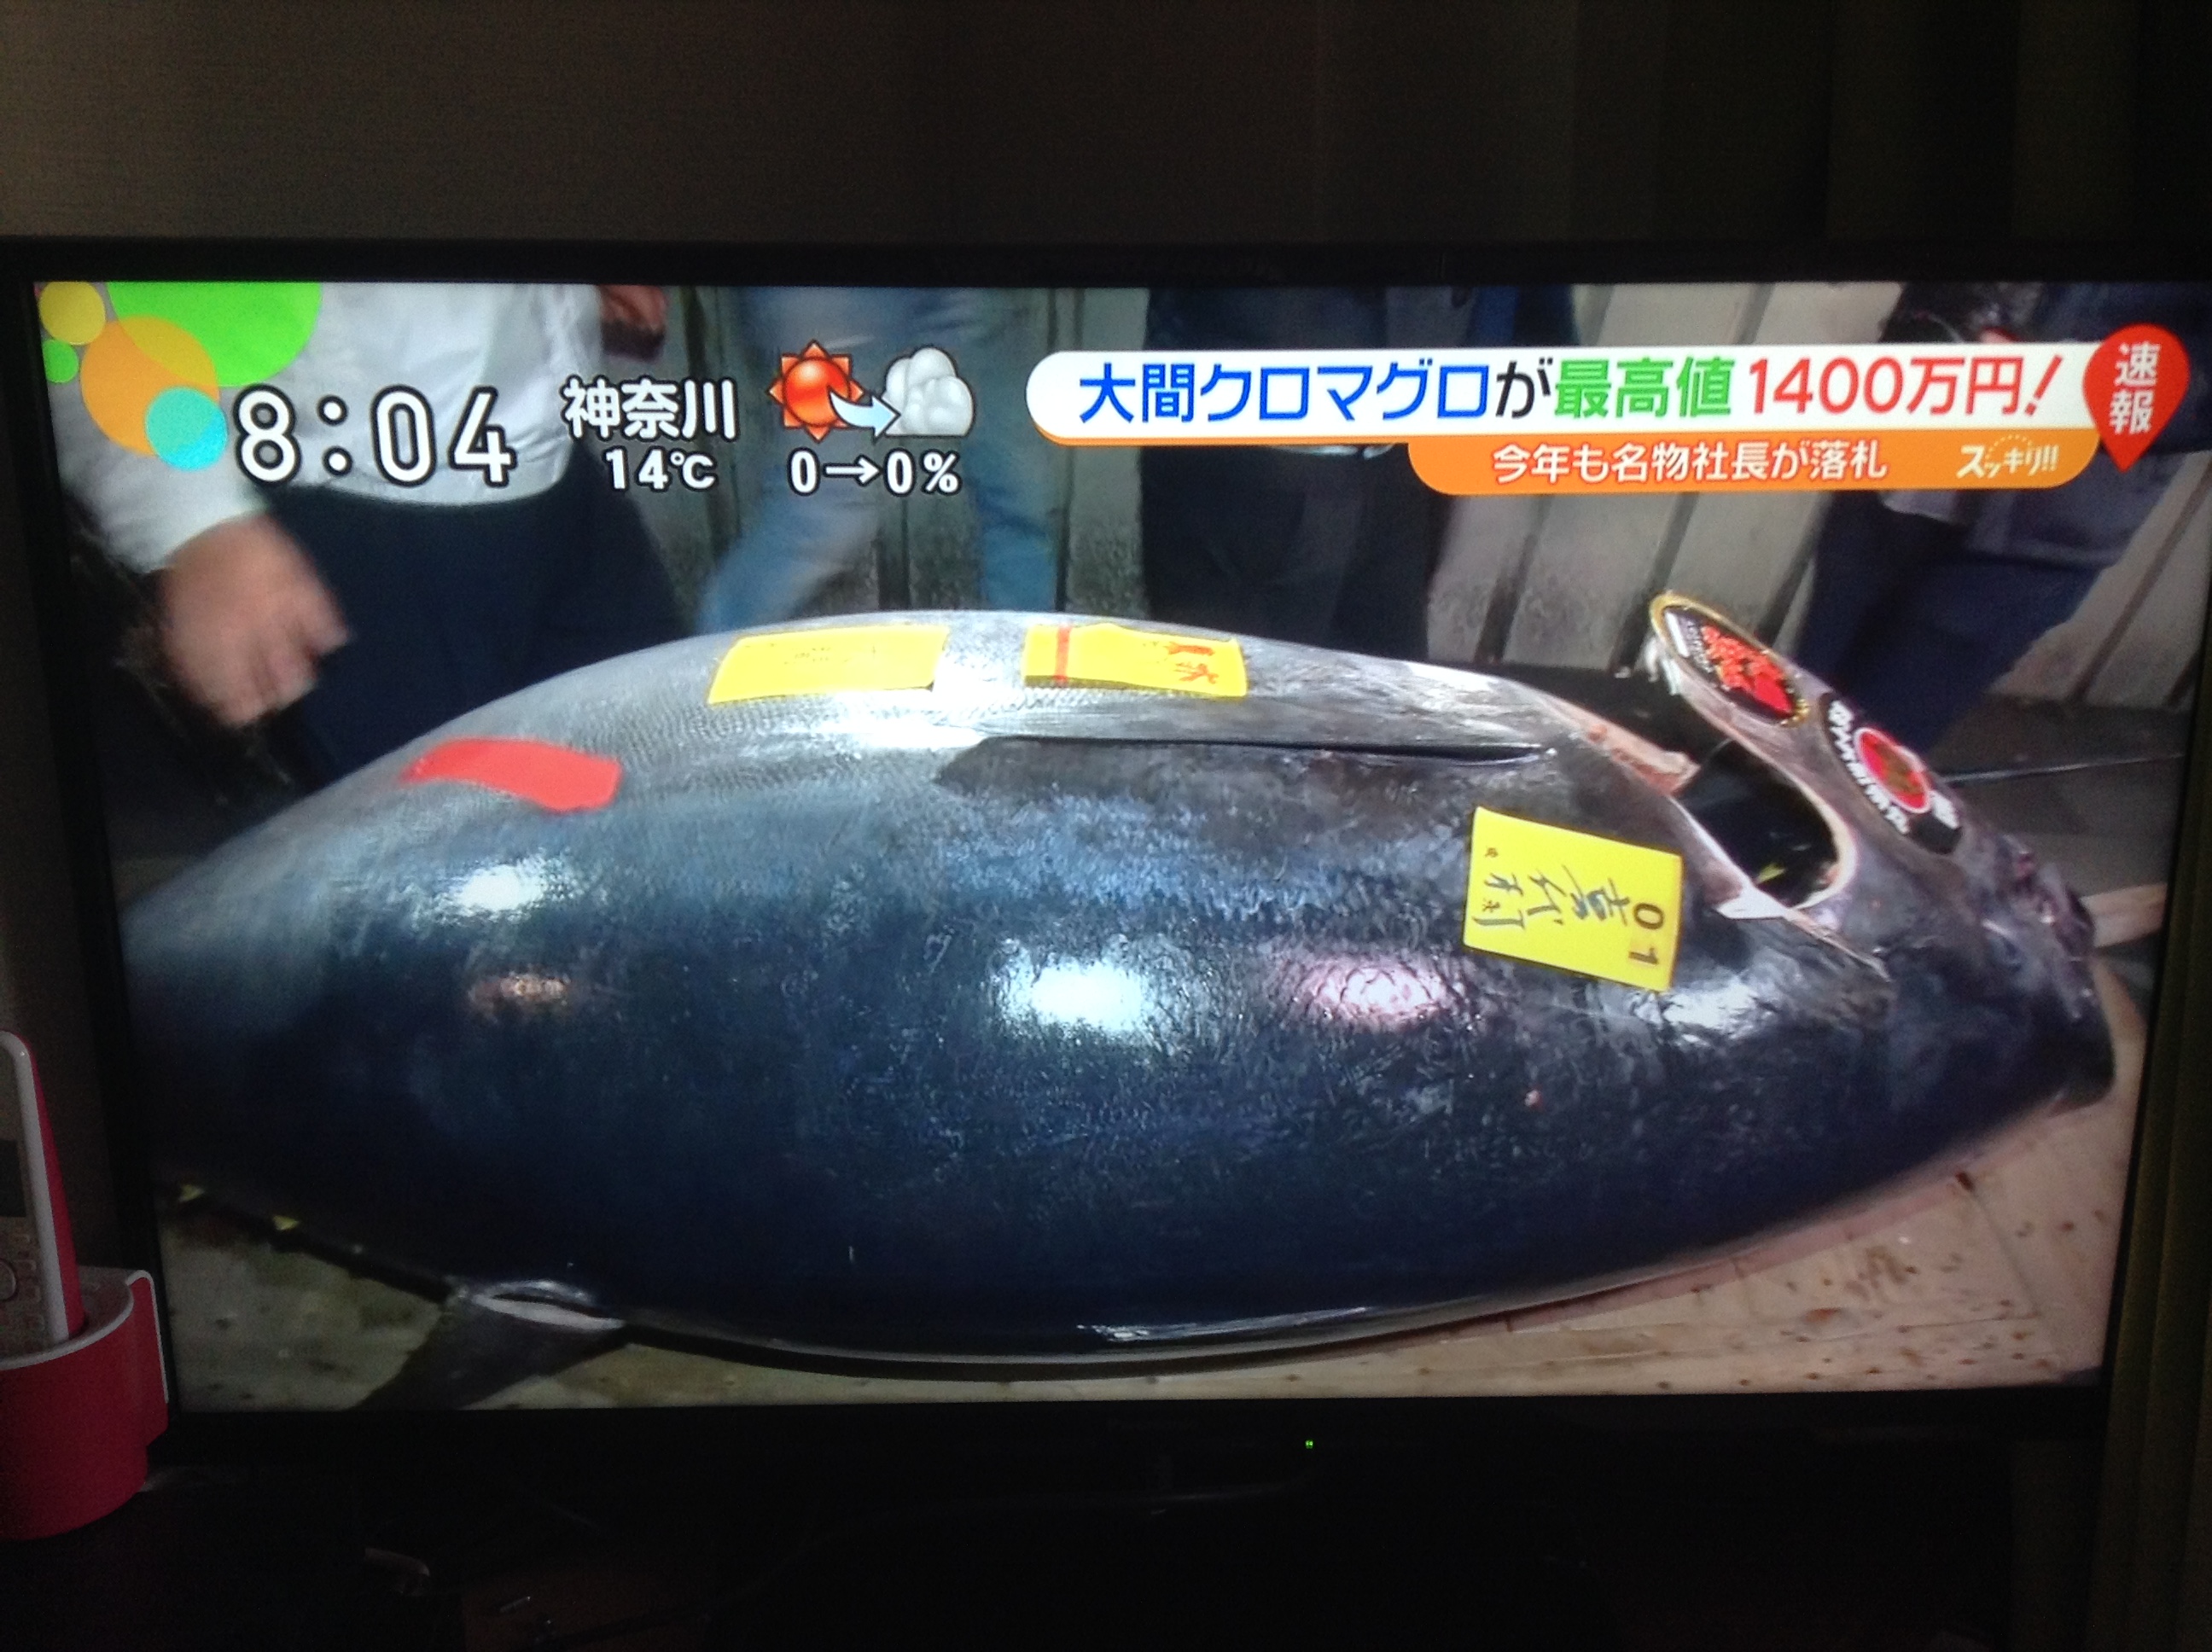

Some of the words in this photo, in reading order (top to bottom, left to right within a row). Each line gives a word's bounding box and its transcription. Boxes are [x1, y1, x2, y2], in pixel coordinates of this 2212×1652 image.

[562, 377, 737, 440] 神奈川
[2109, 340, 2162, 435] 速報
[234, 384, 516, 486] 8:04
[1492, 439, 1889, 486] 今年も名物社長が落札
